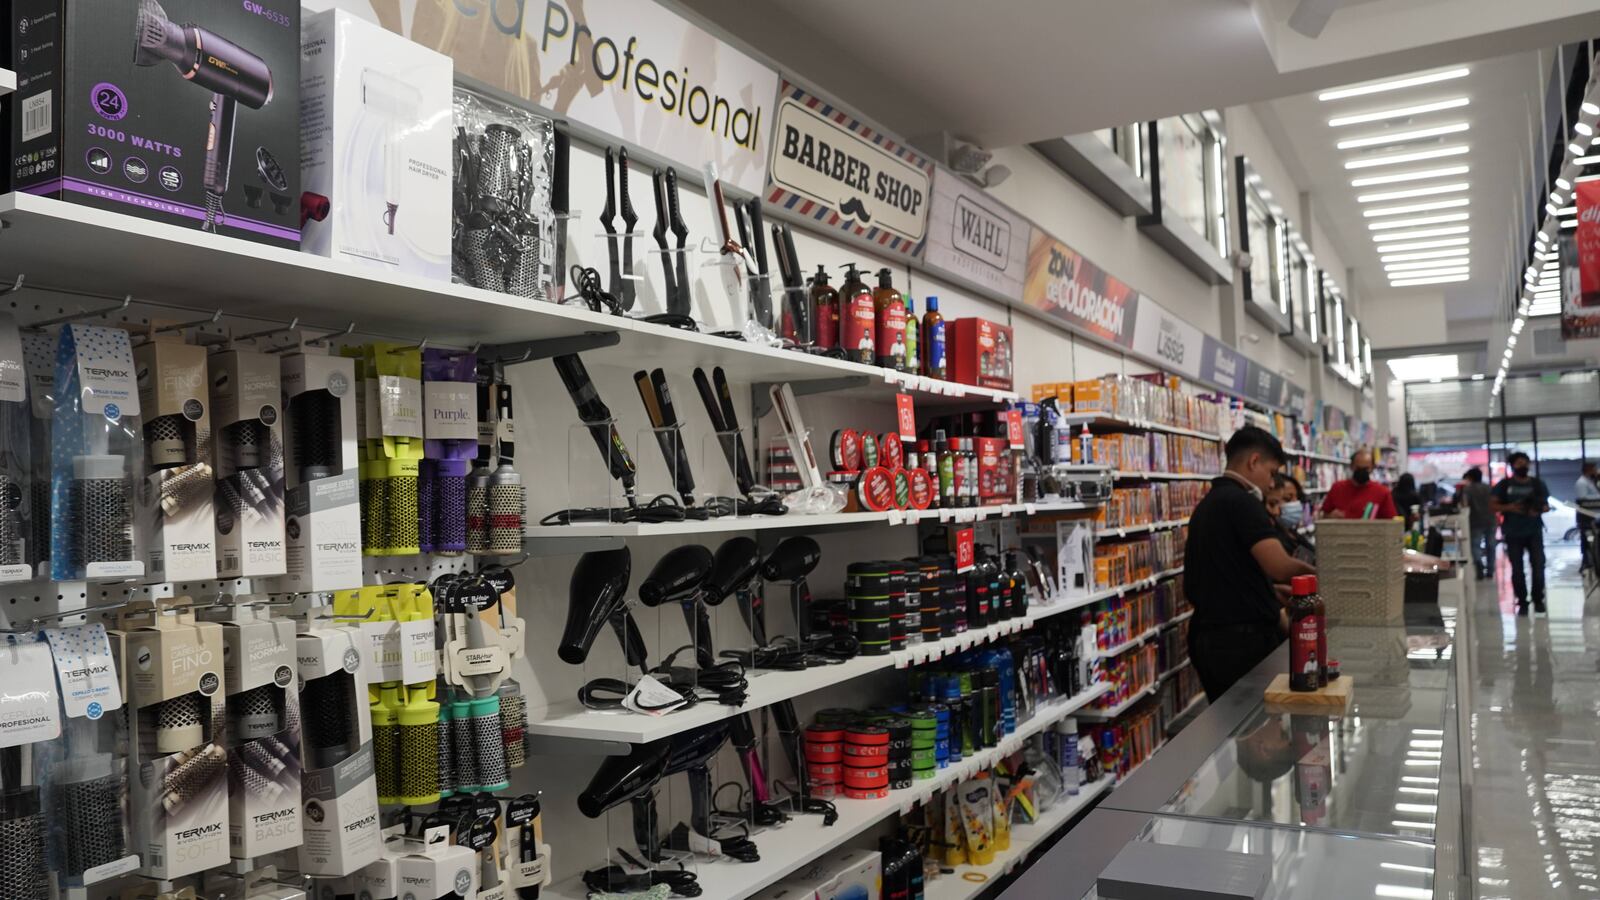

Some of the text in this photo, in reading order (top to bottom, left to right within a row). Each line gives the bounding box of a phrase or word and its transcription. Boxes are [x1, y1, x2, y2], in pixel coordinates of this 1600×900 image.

[243, 0, 290, 27] GW-6535
[541, 0, 761, 151] Profesional
[99, 91, 120, 110] 24
[88, 123, 183, 158] 3000 WATTS
[408, 157, 448, 177] PROFESSIONAL
[408, 165, 440, 180] HAIR DRYER
[782, 124, 922, 216] BARBER SHOP
[88, 187, 187, 215] HIGH TECHNOLOGY
[959, 206, 1004, 258] WAHL
[1047, 247, 1075, 281] ZONA
[1058, 274, 1124, 336] COLORACIÓN
[84, 367, 129, 378] TERMIX
[170, 543, 210, 551] TERMIX
[247, 541, 281, 549] TERMIX
[316, 543, 357, 552] TERMIX
[249, 553, 281, 564] BASIC
[171, 650, 213, 674] FINO
[249, 643, 289, 662] NORMAL
[344, 655, 358, 666] XL
[64, 665, 109, 677] TERMIX
[253, 807, 297, 823] TERMIX
[343, 812, 377, 832] TERMIX
[175, 821, 223, 840] TERMIX
[255, 821, 297, 841] BASIC
[175, 840, 221, 863] SOFT
[456, 875, 471, 888] XL
